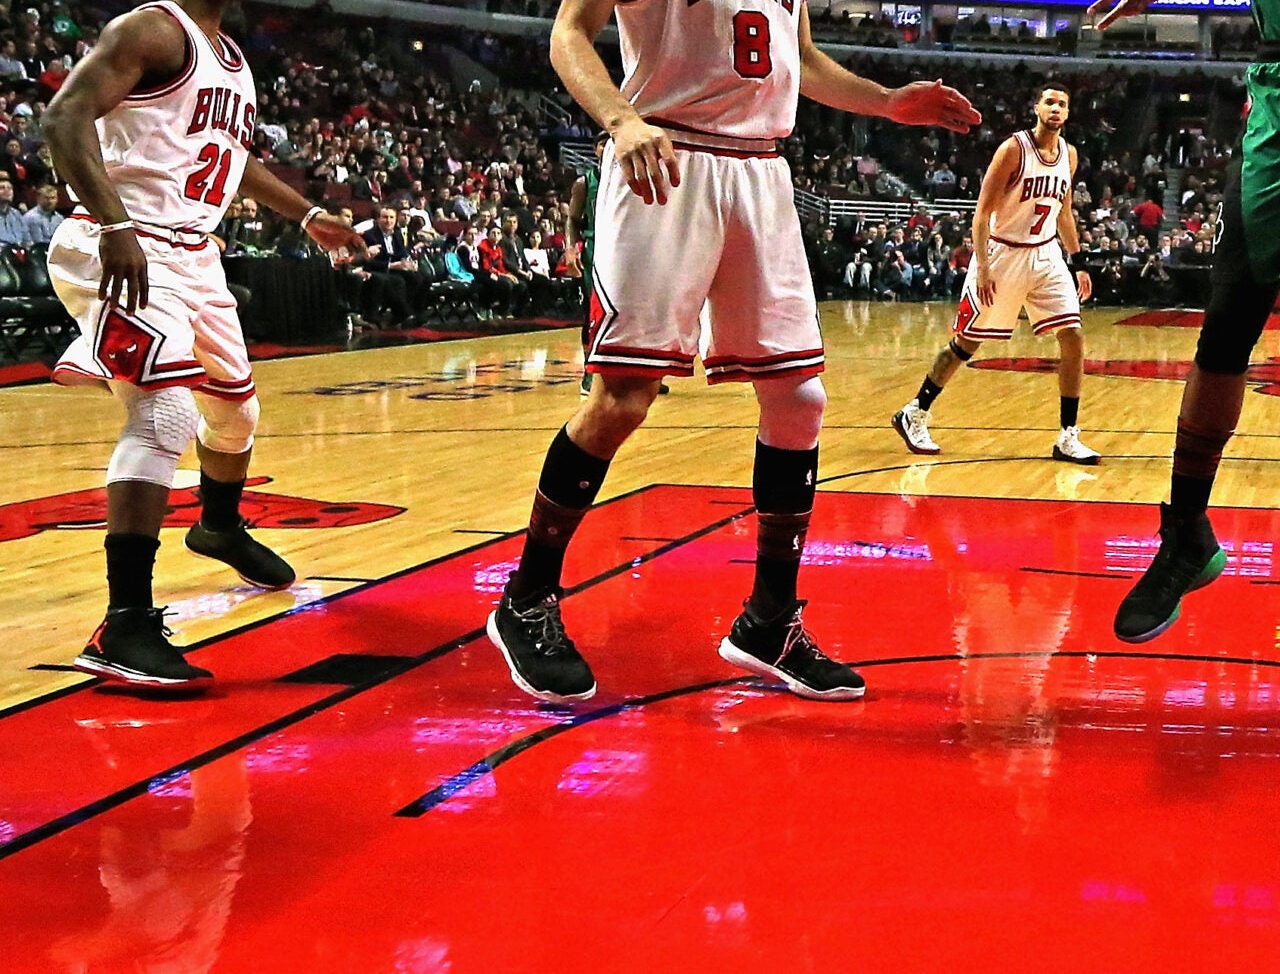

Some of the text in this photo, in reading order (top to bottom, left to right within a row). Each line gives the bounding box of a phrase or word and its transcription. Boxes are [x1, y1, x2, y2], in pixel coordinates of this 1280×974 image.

[732, 9, 773, 80] 8
[186, 87, 256, 151] BULLS
[184, 142, 232, 208] 21
[1020, 175, 1067, 204] BULLS
[1030, 203, 1051, 235] 7
